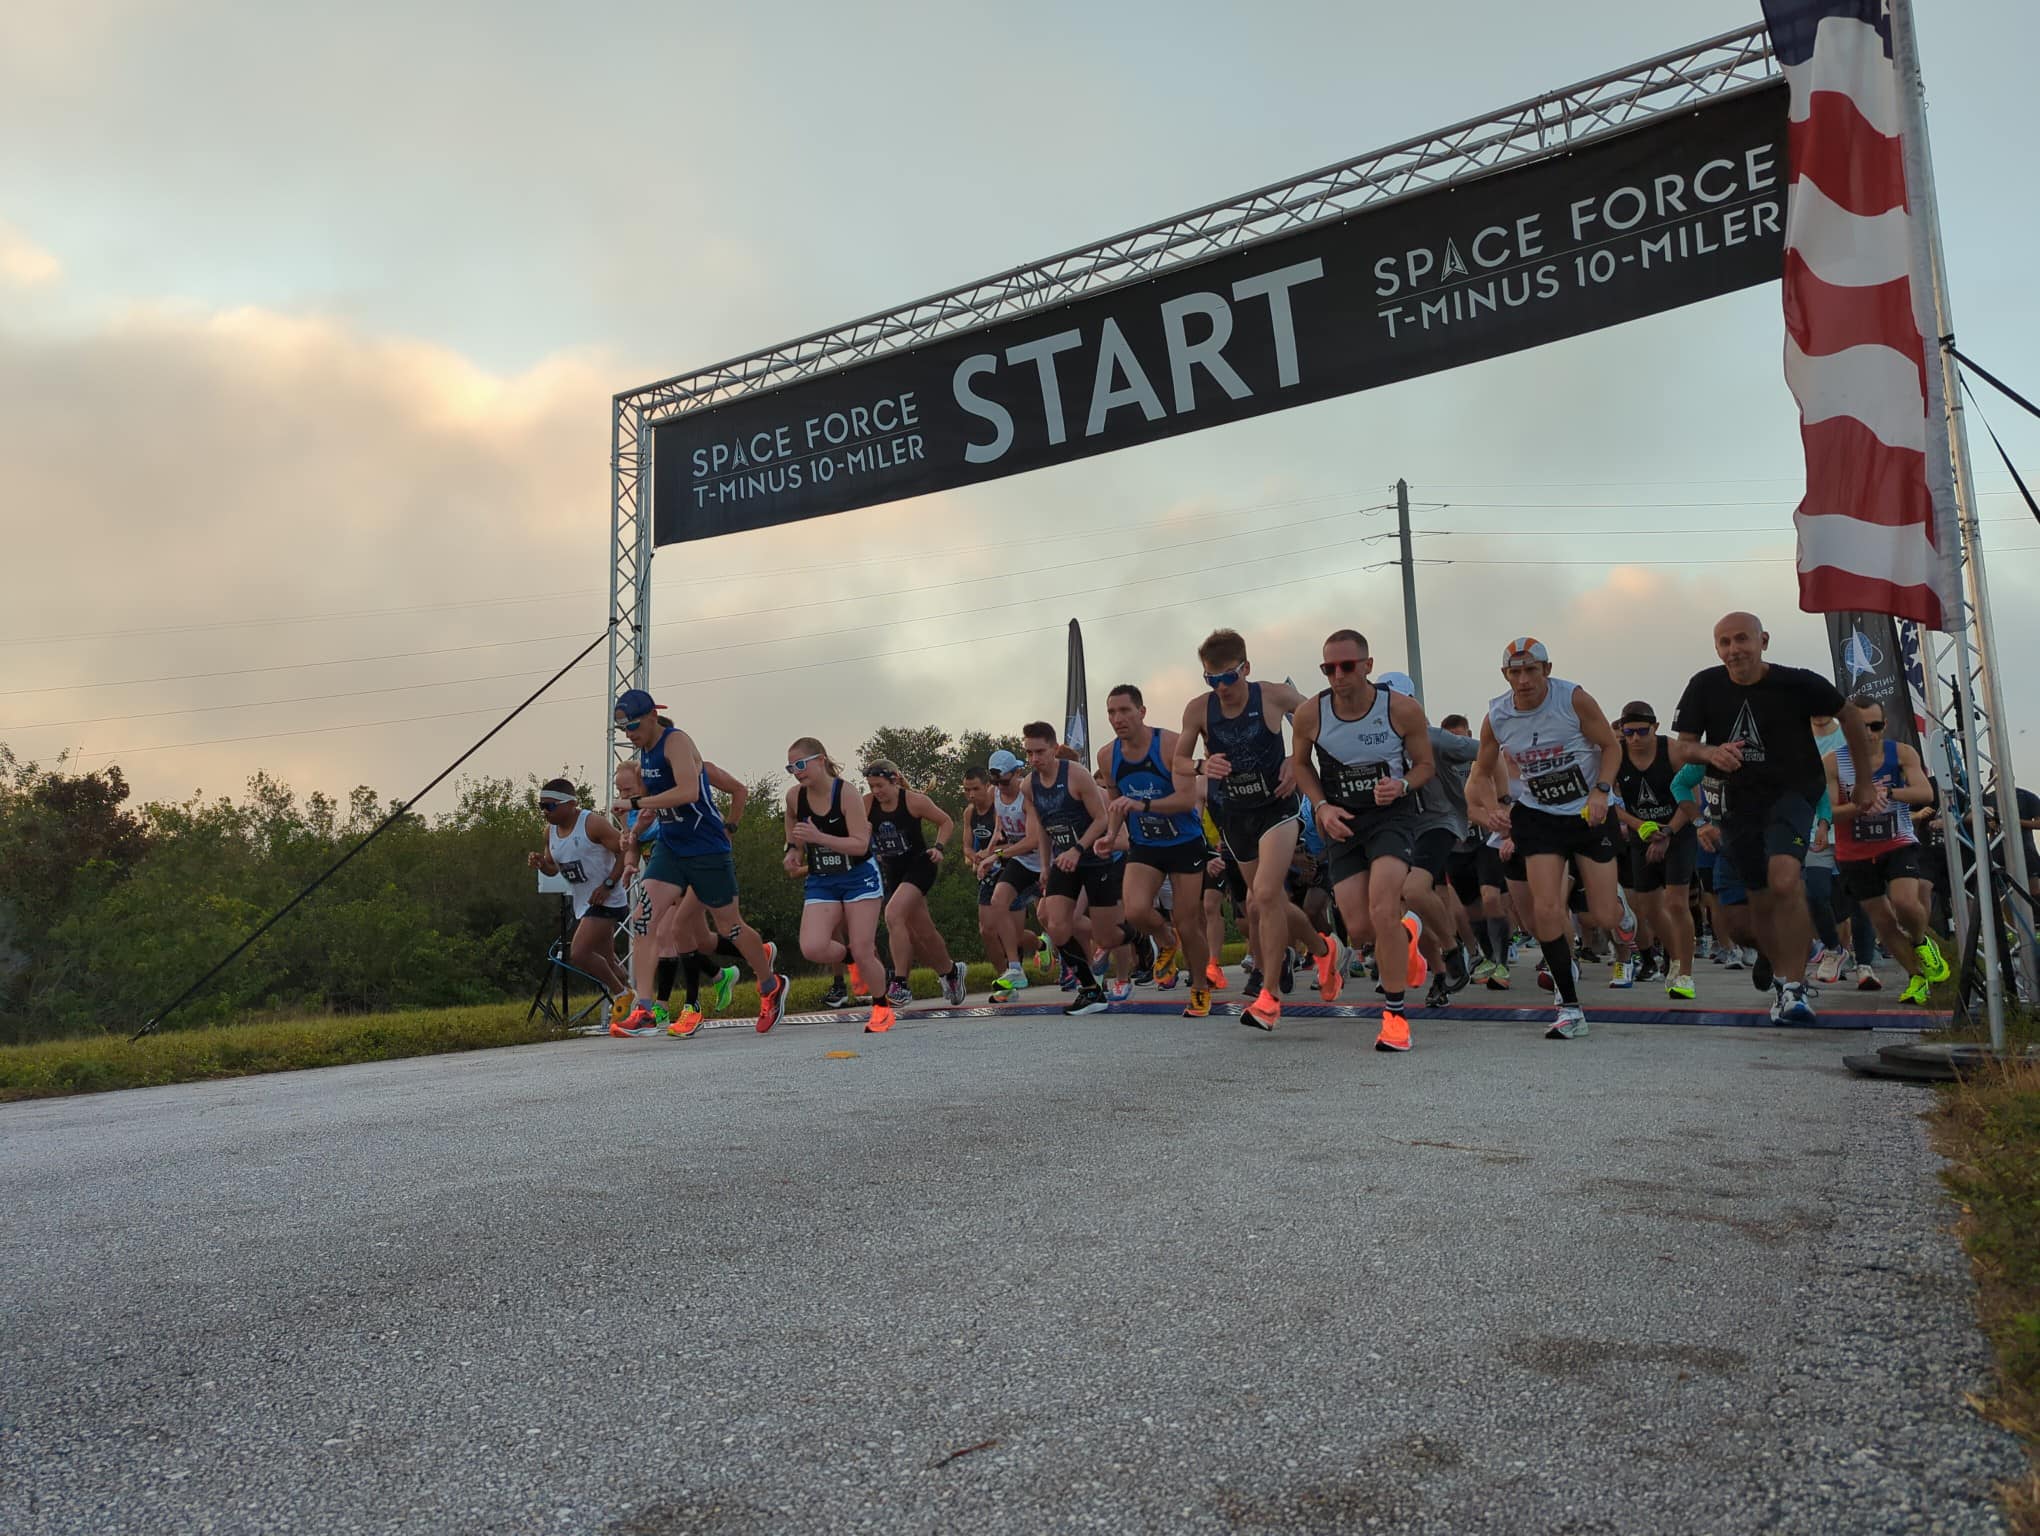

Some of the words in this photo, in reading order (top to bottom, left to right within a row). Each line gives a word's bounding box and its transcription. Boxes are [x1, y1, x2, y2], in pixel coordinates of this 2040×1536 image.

[1373, 213, 1544, 297] SPACE
[1570, 144, 1777, 241] FORCE
[1378, 265, 1560, 339] T-MINUS
[1574, 201, 1781, 288] 10-MILER
[952, 257, 1325, 464] START
[692, 426, 793, 478] SPACE
[805, 391, 919, 449] FORCE
[693, 464, 801, 509] T-MINUS
[810, 434, 925, 484] 10-MILER
[1232, 782, 1262, 796] 1088
[1542, 782, 1576, 800] 1314
[822, 855, 842, 866] 698
